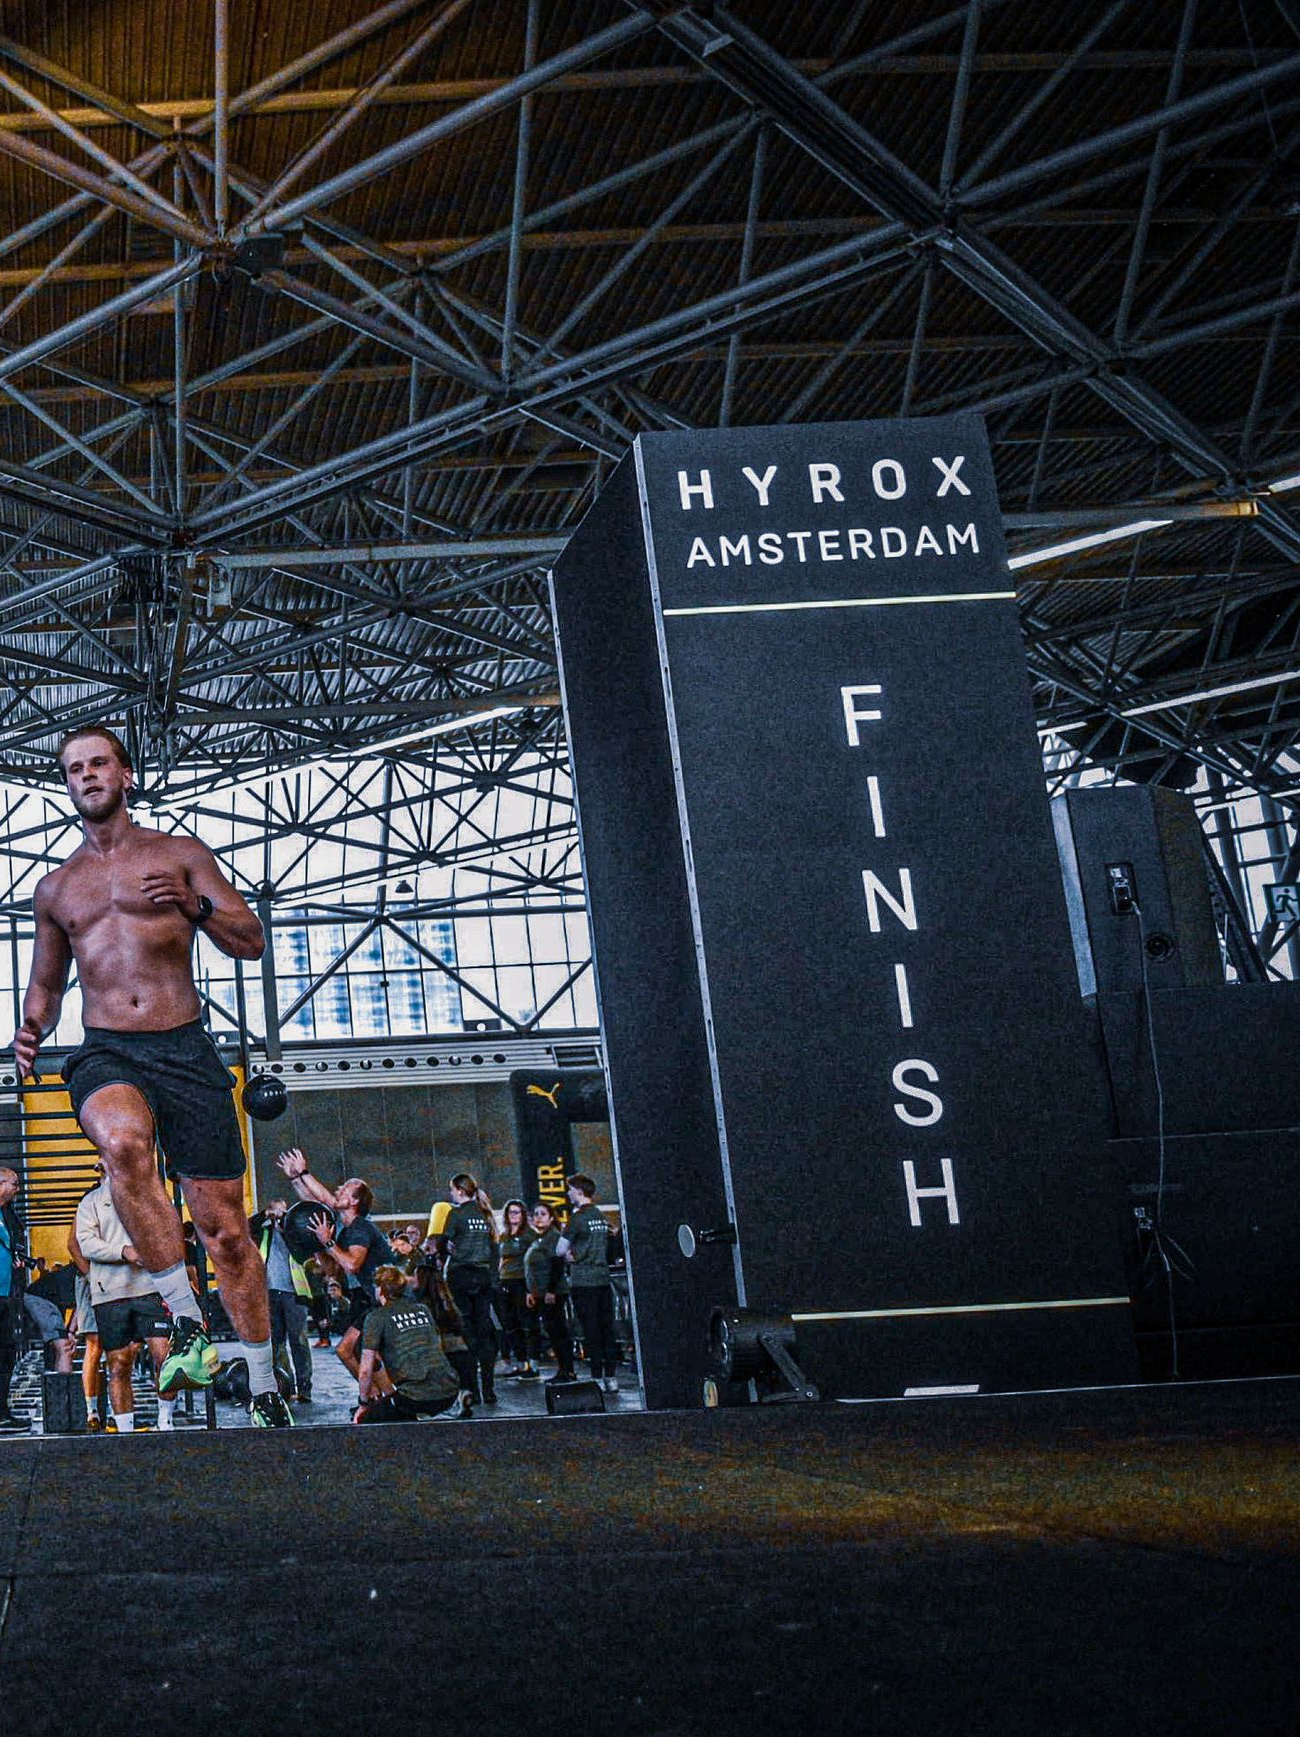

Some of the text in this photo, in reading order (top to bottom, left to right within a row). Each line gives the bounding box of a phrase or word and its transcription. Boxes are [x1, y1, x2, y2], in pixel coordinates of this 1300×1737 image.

[677, 455, 971, 511] HYROX
[686, 523, 980, 569] AMSTERDAM
[840, 684, 960, 1227] FINISH
